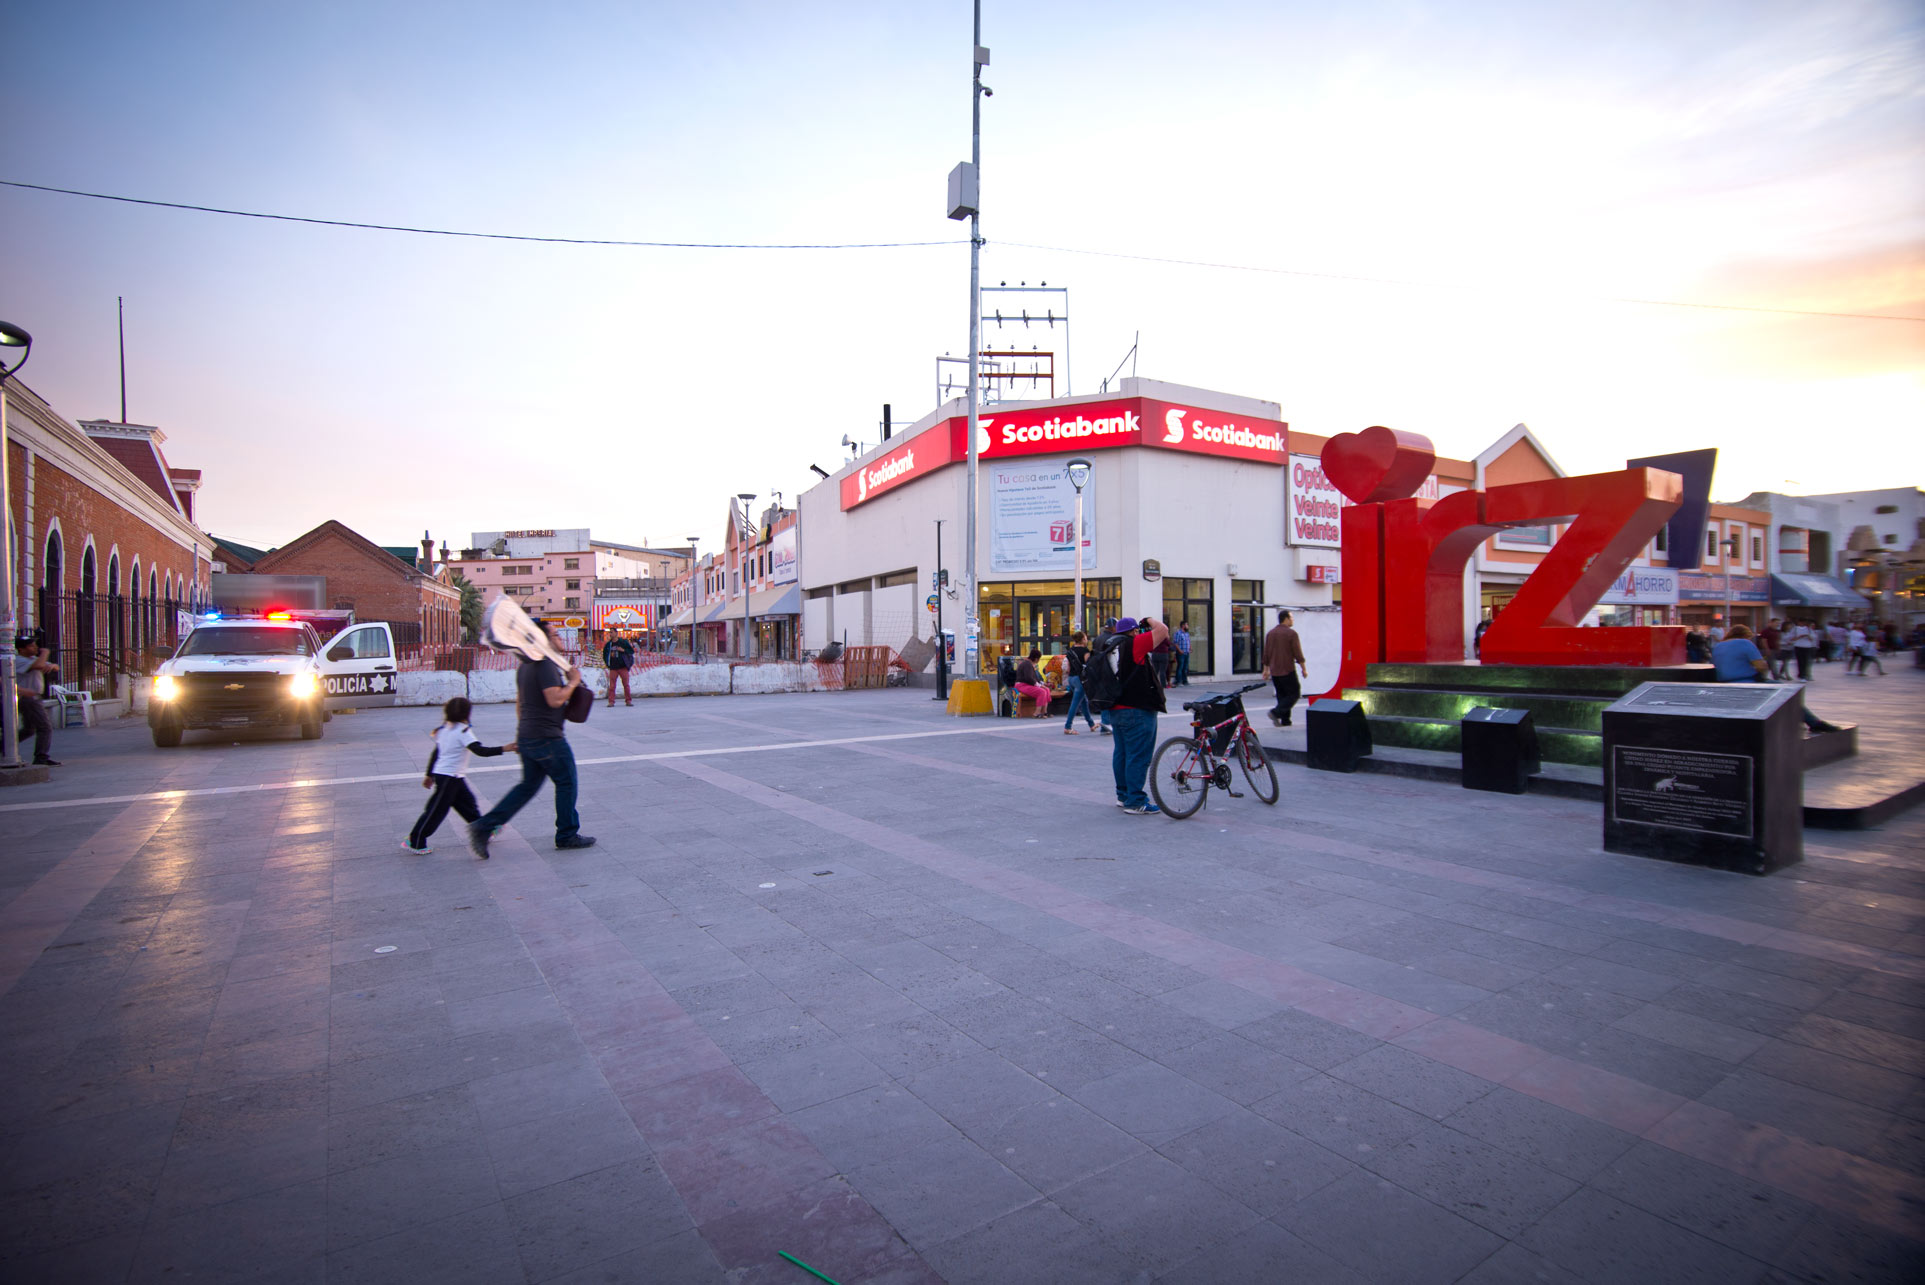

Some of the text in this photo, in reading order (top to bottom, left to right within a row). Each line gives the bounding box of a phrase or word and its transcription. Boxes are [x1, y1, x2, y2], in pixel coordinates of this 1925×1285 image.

[1002, 411, 1141, 444] Scotiabank
[1192, 420, 1285, 452] Scotiabank
[869, 448, 914, 489] Scotiabank
[998, 474, 1010, 484] Tu
[1012, 474, 1037, 483] casa
[1050, 473, 1061, 481] un
[1294, 494, 1339, 519] Veinte
[1052, 527, 1062, 541] 7
[1295, 517, 1339, 541] Veinte
